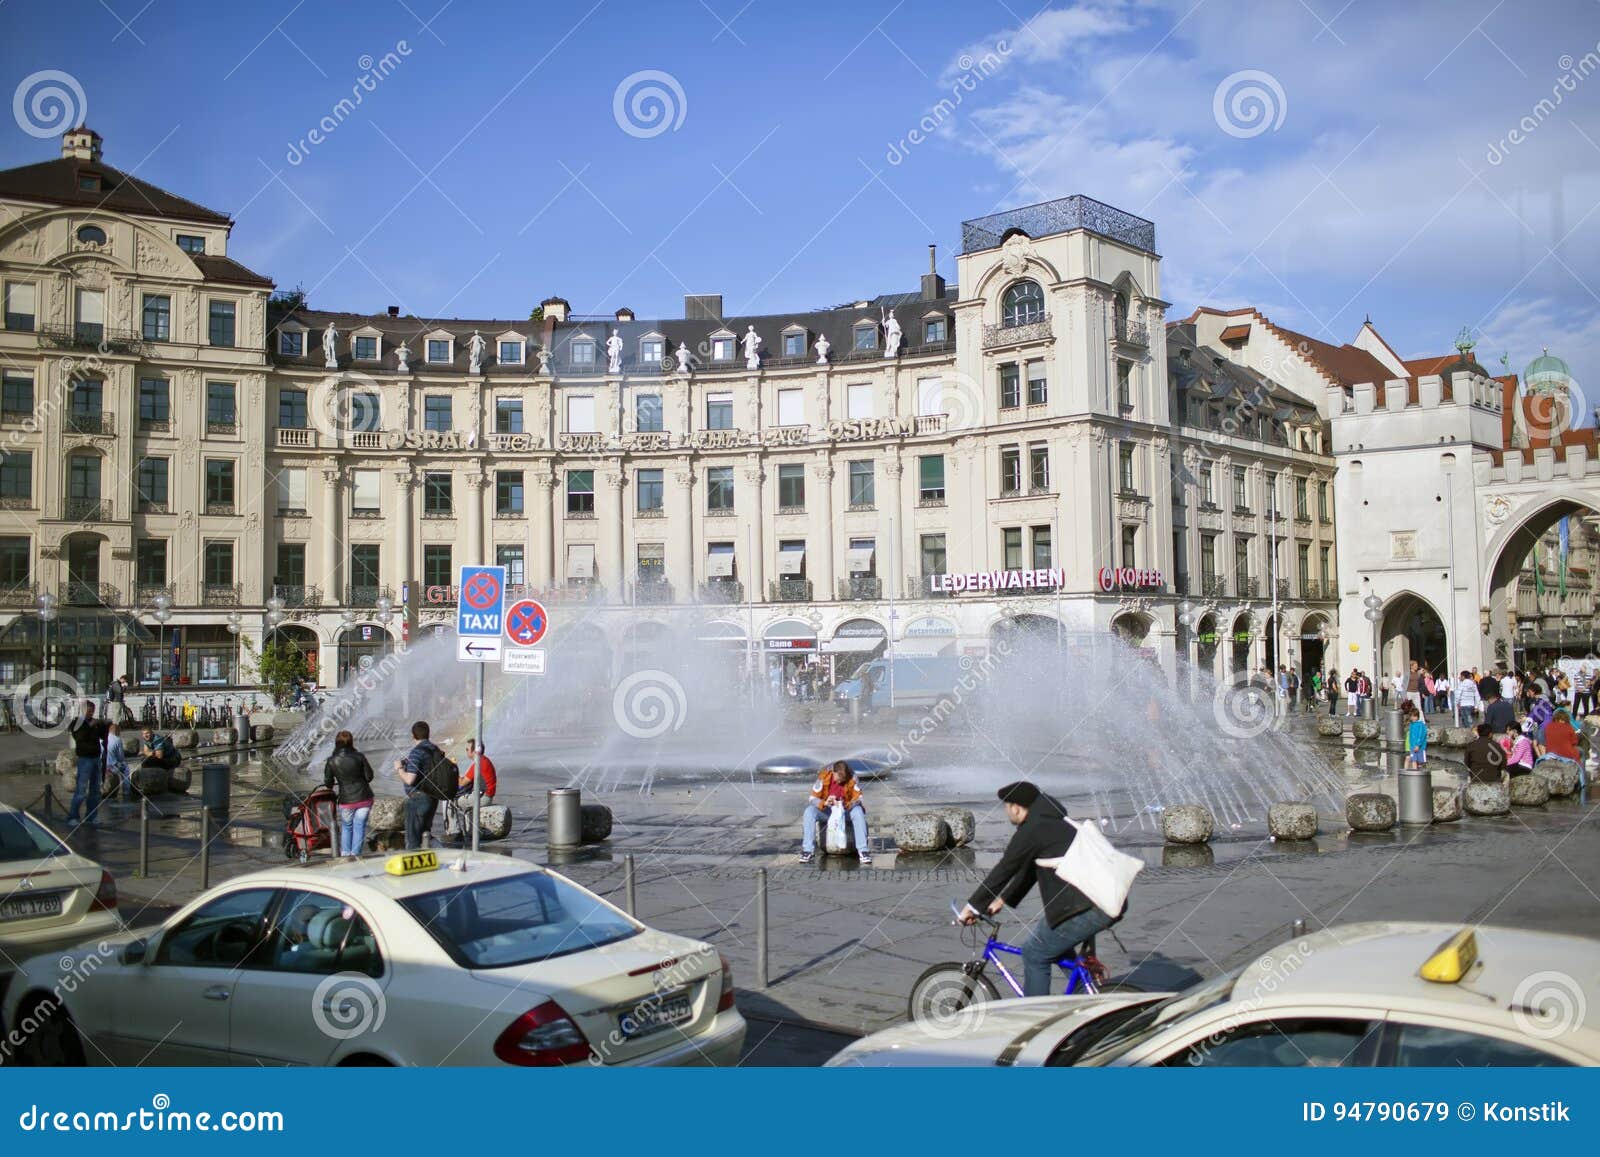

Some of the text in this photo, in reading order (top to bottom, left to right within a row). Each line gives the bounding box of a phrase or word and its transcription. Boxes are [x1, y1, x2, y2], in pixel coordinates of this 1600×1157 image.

[387, 428, 478, 450] OSRAM
[826, 415, 915, 441] OSRAM
[930, 568, 1065, 592] LEDERWAREN
[1116, 566, 1164, 587] KOFFER
[462, 613, 499, 630] TAXI
[402, 852, 437, 871] TAXI
